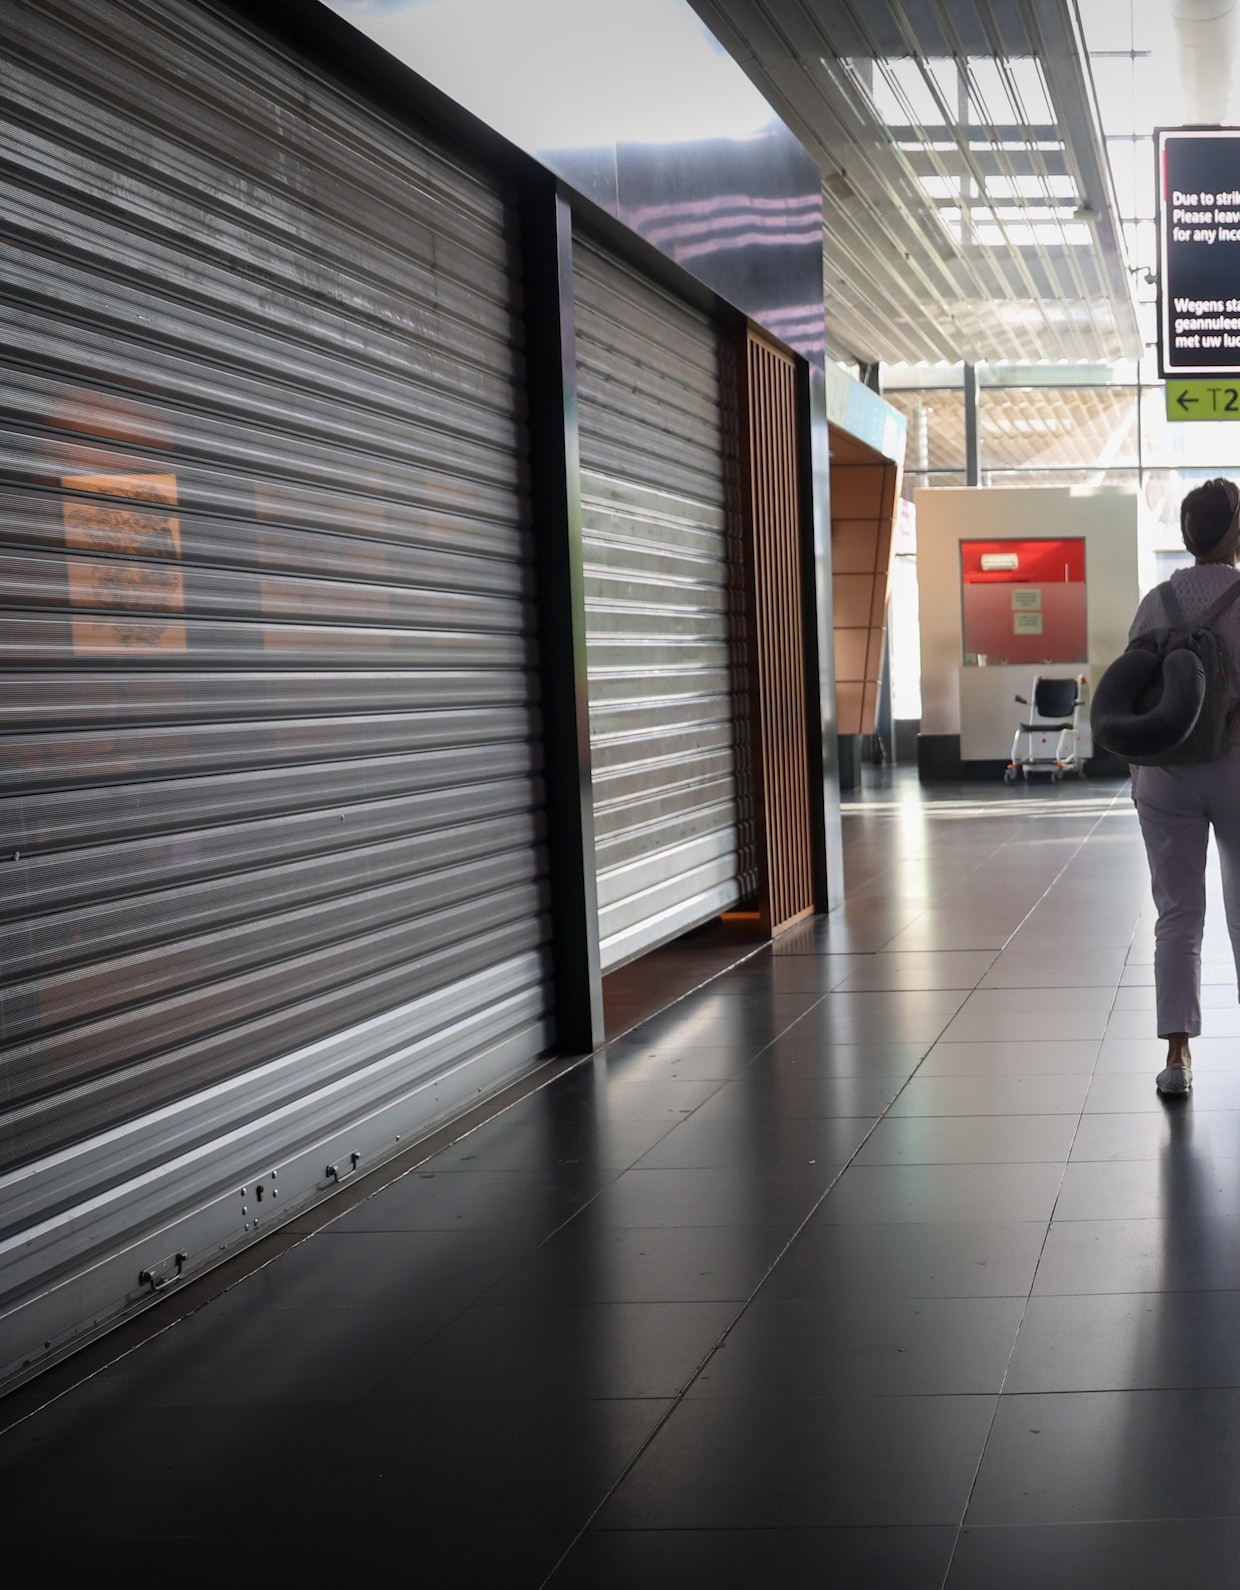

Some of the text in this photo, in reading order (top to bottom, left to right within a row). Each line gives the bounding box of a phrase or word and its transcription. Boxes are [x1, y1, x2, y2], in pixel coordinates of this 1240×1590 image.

[1172, 191, 1199, 206] Due
[1199, 192, 1215, 205] to
[1173, 209, 1213, 224] Please
[1173, 227, 1193, 241] for
[1192, 230, 1217, 244] any
[1174, 298, 1225, 315] Wegens
[1175, 333, 1200, 347] met
[1201, 336, 1222, 347] uw
[1207, 388, 1239, 412] T2
